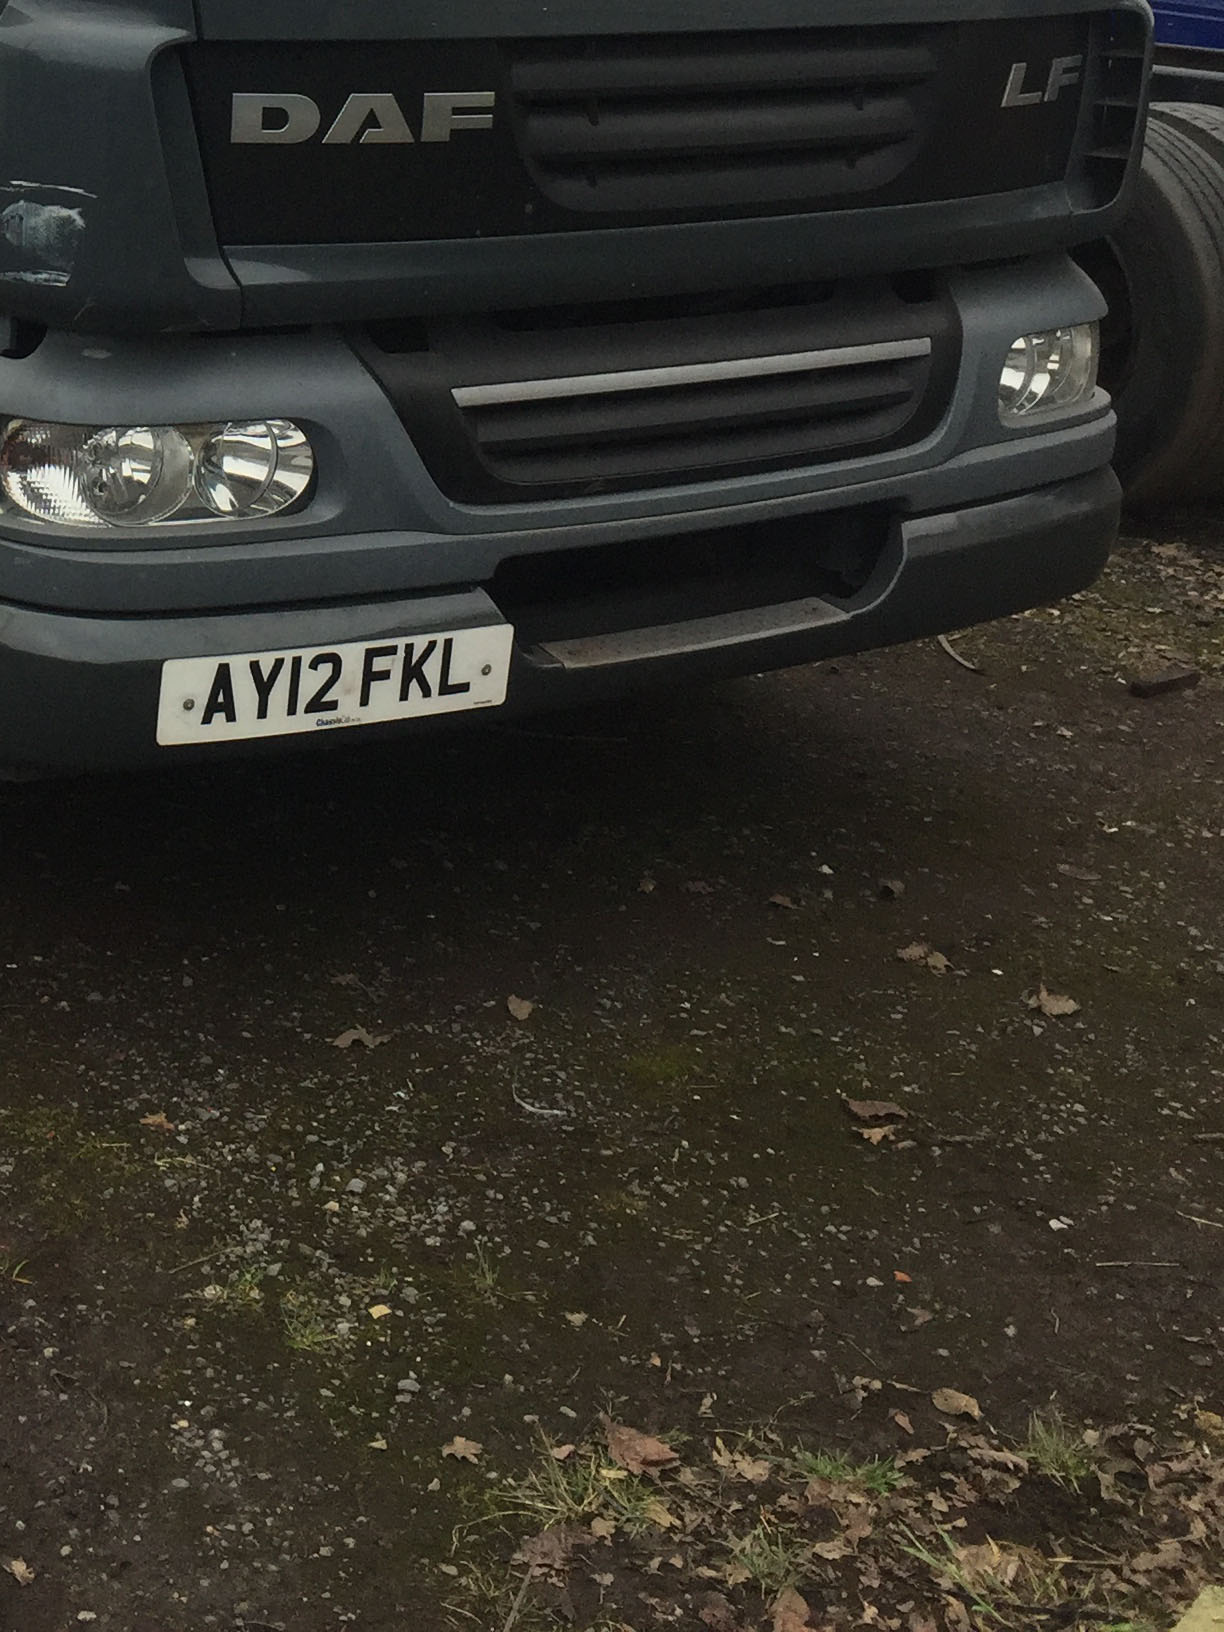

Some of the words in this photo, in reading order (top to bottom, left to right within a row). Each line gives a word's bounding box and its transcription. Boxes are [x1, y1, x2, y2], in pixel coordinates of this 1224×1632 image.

[1000, 54, 1084, 108] LF
[230, 91, 496, 144] DAF
[200, 651, 343, 726] AY12
[359, 637, 471, 708] FKL
